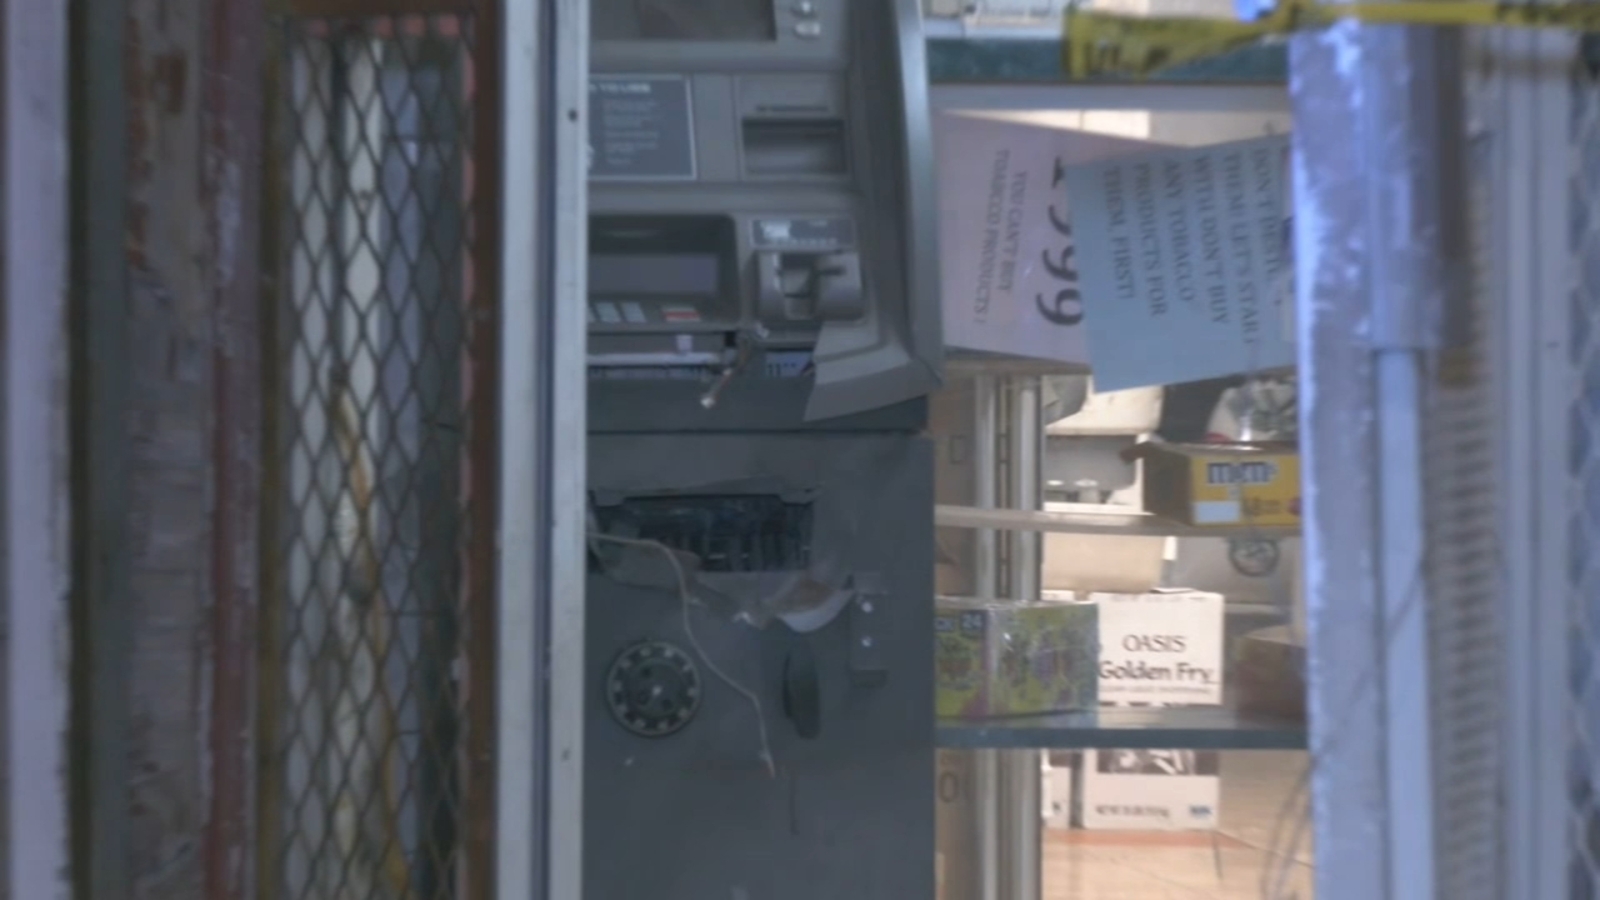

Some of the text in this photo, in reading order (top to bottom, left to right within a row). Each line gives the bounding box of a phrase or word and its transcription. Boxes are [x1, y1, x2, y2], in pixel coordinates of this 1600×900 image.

[1002, 207, 1023, 258] CAN'T
[1111, 236, 1134, 300] FIRST!
[1132, 163, 1168, 318] PRODUCTS FOR
[1163, 160, 1194, 303] ANY TOBACCO
[1193, 155, 1230, 326] WITH DON'T BUY
[973, 228, 1000, 315] PRODUCTS
[1099, 660, 1215, 685] Golden Fry
[1121, 634, 1187, 653] OASIS
